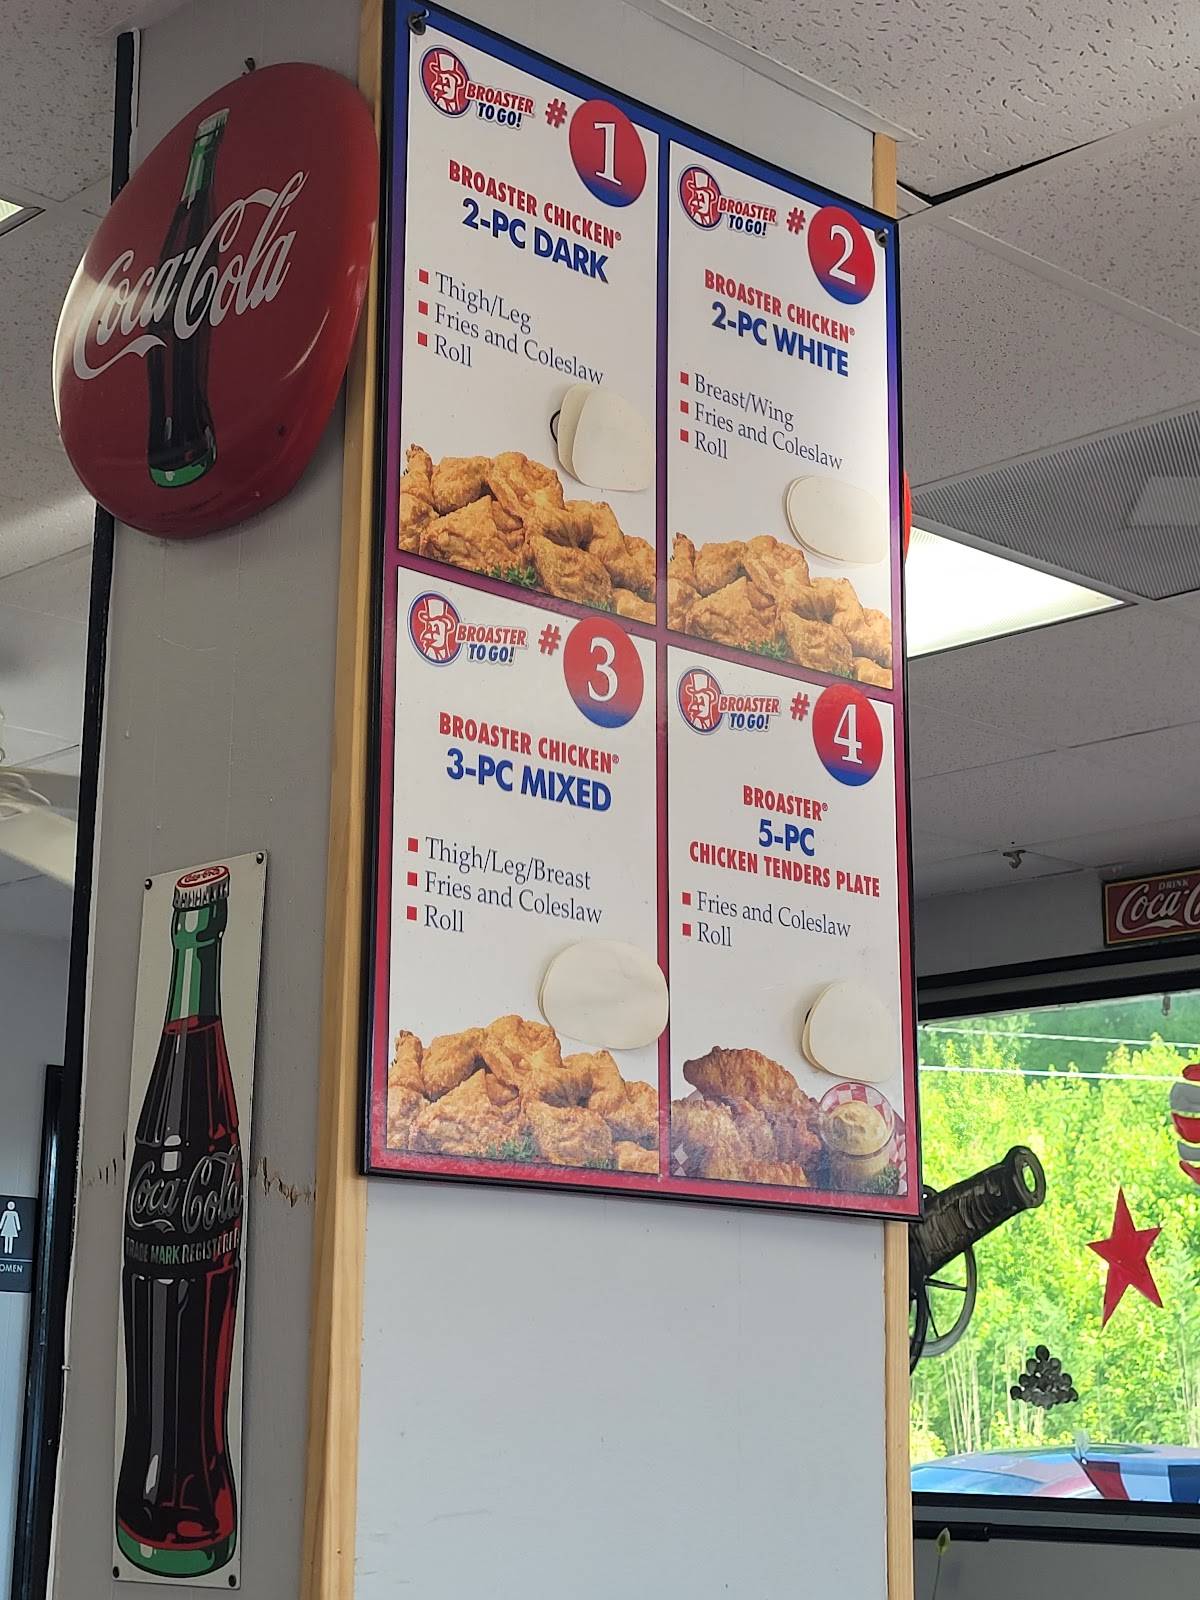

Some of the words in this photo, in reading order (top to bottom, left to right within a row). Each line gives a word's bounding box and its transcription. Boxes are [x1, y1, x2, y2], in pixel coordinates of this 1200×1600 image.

[466, 81, 534, 114] BROASTER
[545, 98, 568, 128] #
[593, 122, 622, 185] 1
[449, 159, 537, 217] BROASTER
[718, 195, 777, 223] BROASTER
[462, 197, 526, 250] 2-PC
[534, 227, 609, 284] DARK
[787, 207, 806, 235] #
[829, 224, 857, 285] 2
[73, 170, 309, 380] Coca-Cola
[435, 271, 532, 334] Thigh/Leg
[704, 268, 782, 318] BROASTER
[434, 334, 473, 368] Roll
[435, 303, 479, 339] Fries
[484, 322, 518, 354] and
[524, 339, 603, 385] Coleslaw
[711, 301, 768, 347] 2-PC
[773, 323, 849, 378] WHITE
[695, 372, 794, 432] Breast/Wing
[695, 401, 734, 433] Fries
[738, 418, 768, 446] and
[772, 431, 843, 472] Coleslaw
[695, 431, 728, 460] Roll
[456, 622, 527, 646] BROASTER
[538, 624, 562, 656] #
[587, 636, 618, 703] 3
[719, 694, 780, 713] BROASTER
[790, 691, 810, 722] #
[833, 703, 863, 765] 4
[439, 711, 532, 755] BROASTER
[446, 747, 513, 792] 3-PC
[520, 765, 612, 813] MIXED
[425, 835, 591, 891] Thigh/Leg/Breast
[758, 818, 815, 857] 5-PC
[689, 841, 758, 874] CHICKEN
[763, 855, 831, 888] TENDERS
[836, 870, 880, 898] PLATE
[1159, 880, 1189, 890] DRINK
[423, 904, 465, 934] Roll
[424, 870, 472, 902] Fries
[477, 882, 512, 909] and
[518, 888, 602, 925] Coleslaw
[697, 890, 738, 918] Fries
[742, 903, 773, 924] and
[778, 907, 851, 937] Coleslaw
[1116, 882, 1200, 934] Coca-C
[697, 921, 732, 947] Roll
[128, 1144, 242, 1233] Coca-Cola
[0, 1264, 23, 1272] OMEN
[150, 1244, 180, 1264] MARK
